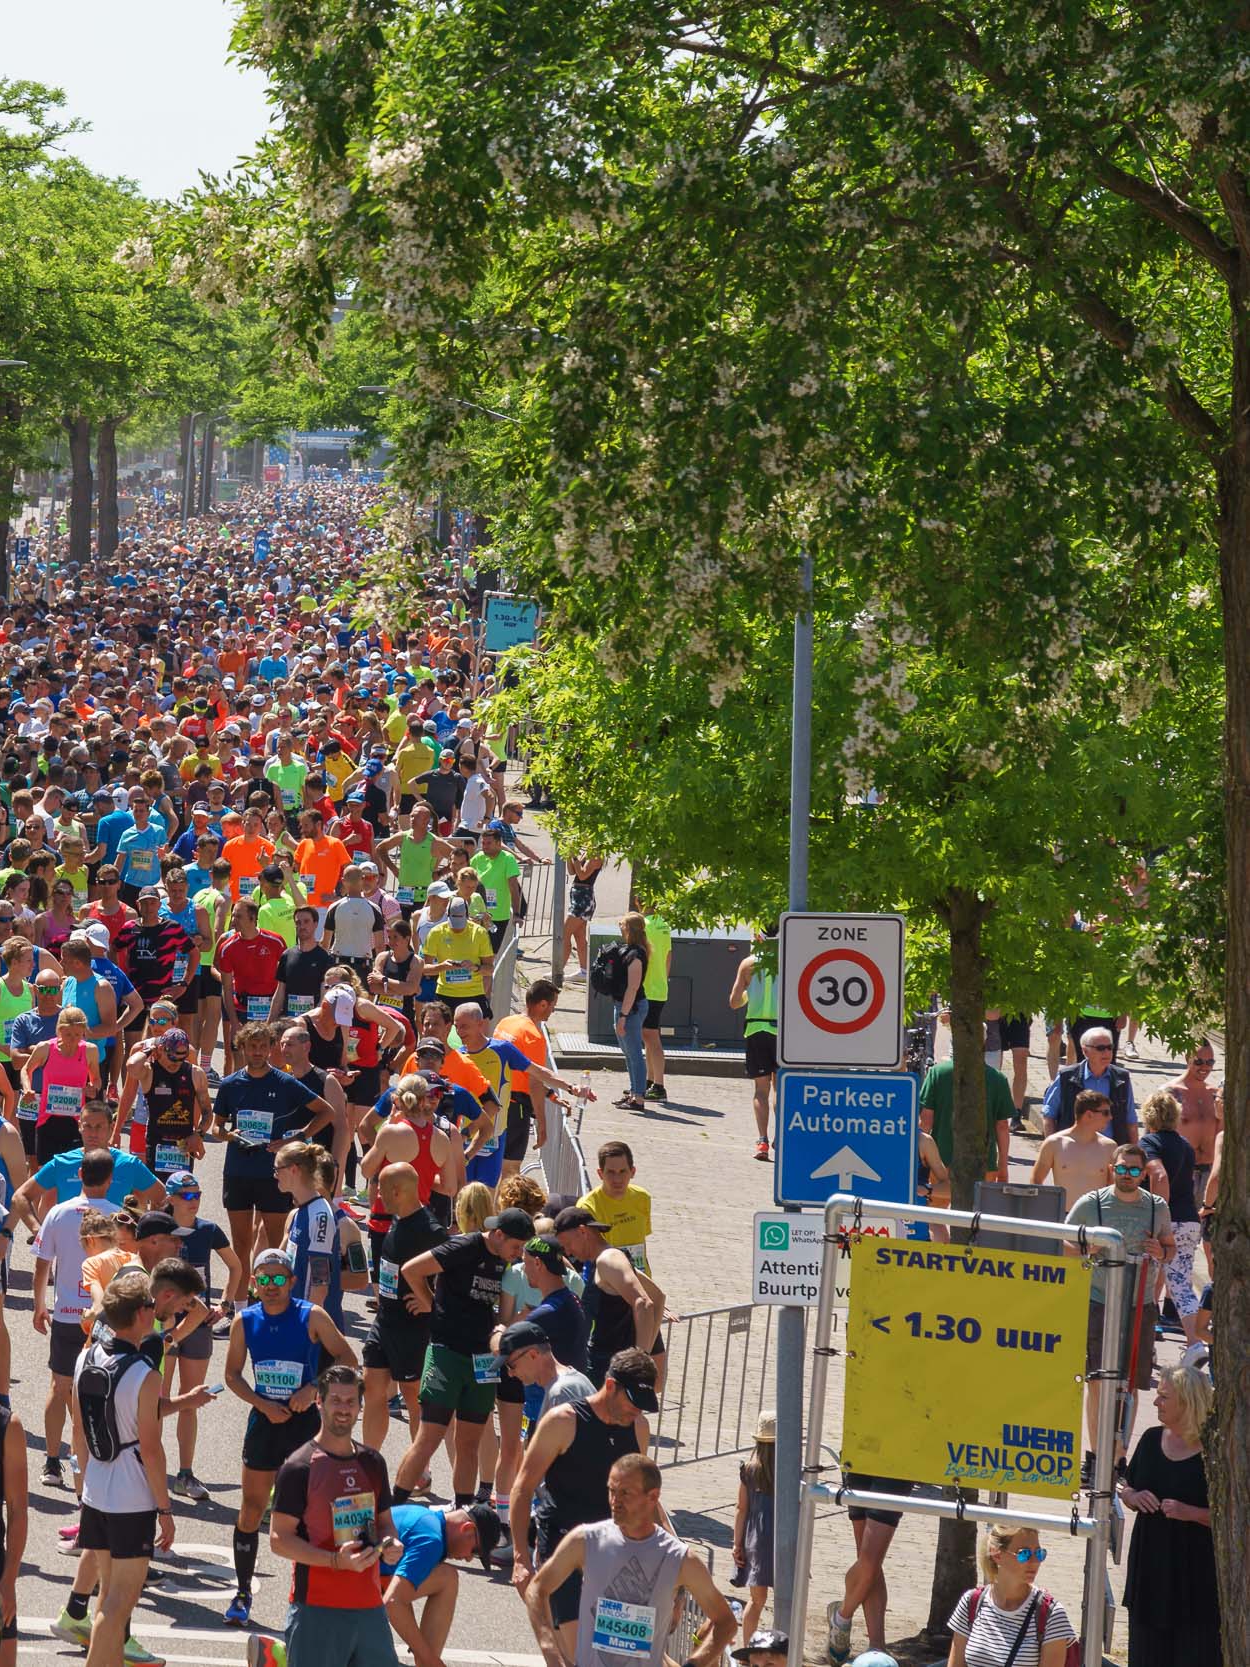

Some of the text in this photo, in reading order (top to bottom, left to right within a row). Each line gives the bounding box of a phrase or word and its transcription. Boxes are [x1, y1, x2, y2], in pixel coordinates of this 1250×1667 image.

[818, 927, 867, 941] ZONE
[815, 976, 868, 1007] 30
[803, 1085, 897, 1108] Parkeer
[788, 1112, 907, 1135] Automaat
[759, 1260, 824, 1276] Attenti
[876, 1247, 1067, 1285] STARTVAK HM
[904, 1311, 982, 1344] 1.30
[996, 1327, 1062, 1353] uur
[257, 1374, 295, 1387] M31100
[947, 1441, 1073, 1477] VENLOOP
[597, 1619, 647, 1638] M45408
[608, 1637, 637, 1649] Marc
